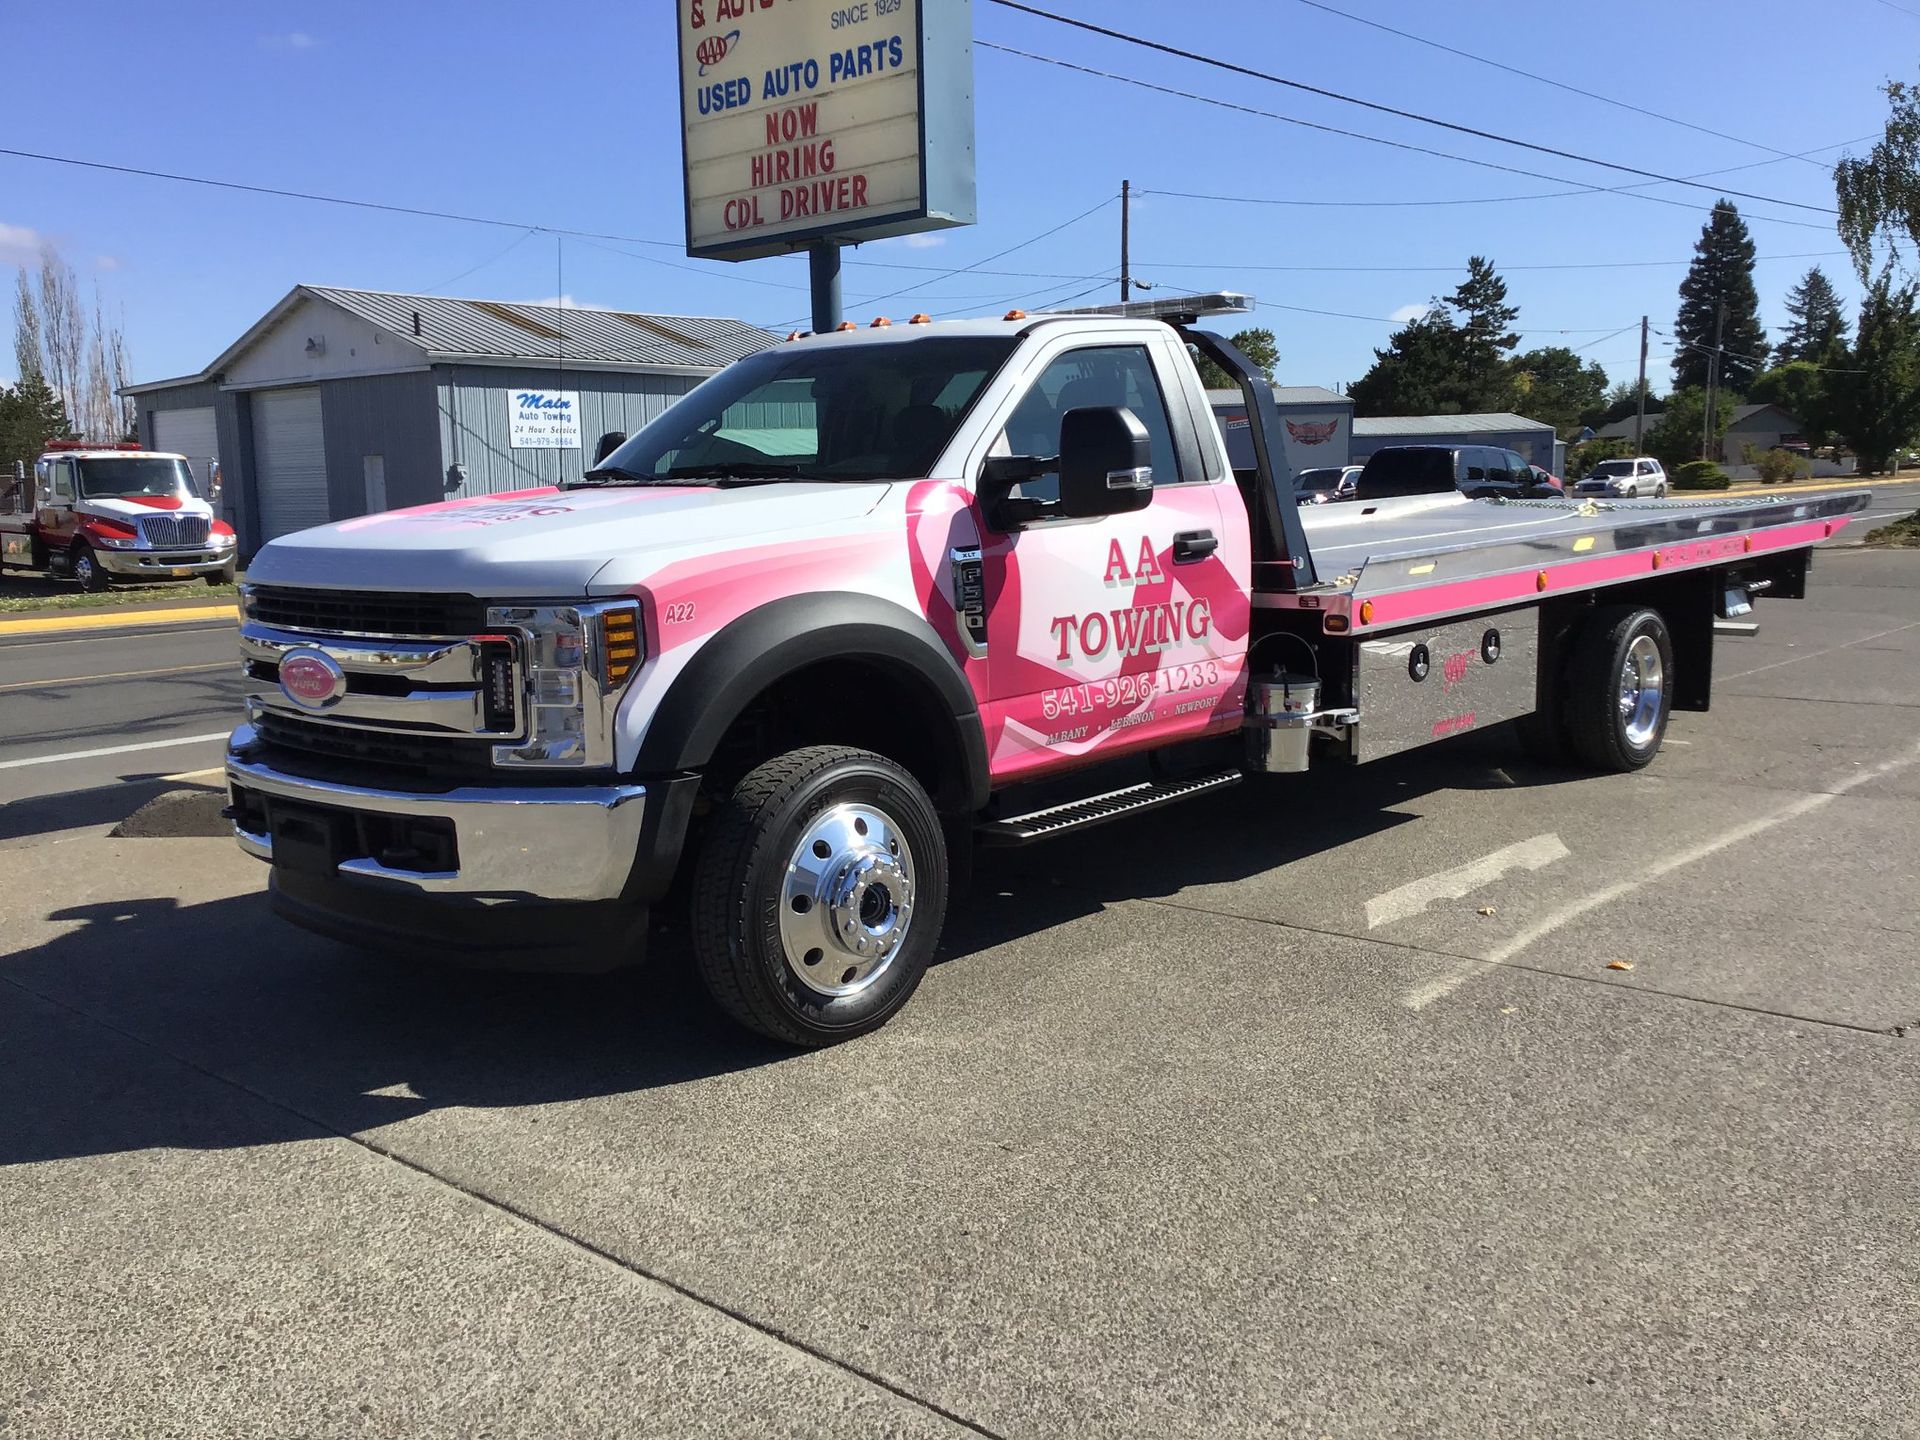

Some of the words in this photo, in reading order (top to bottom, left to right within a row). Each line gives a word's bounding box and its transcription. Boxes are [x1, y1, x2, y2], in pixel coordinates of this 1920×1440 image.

[716, 0, 774, 22] AU
[831, 3, 868, 30] SINCE
[874, 0, 901, 16] 1929
[697, 37, 726, 64] AAA
[698, 77, 751, 115] USED
[763, 59, 818, 99] AUTO
[830, 35, 903, 83] PARTS
[766, 103, 817, 145] NOW
[751, 140, 835, 187] HIRING
[723, 195, 764, 230] CDL
[780, 174, 867, 220] DRIVER
[516, 393, 571, 409] Main
[519, 411, 539, 420] Auto
[542, 411, 571, 423] Towing
[514, 425, 524, 433] 24
[528, 425, 546, 434] Hour
[550, 425, 577, 434] Service
[1103, 535, 1165, 587] AA
[664, 602, 695, 625] A22
[1050, 597, 1212, 665] TOWING
[1041, 661, 1219, 720] 541-926-1233
[1046, 725, 1089, 746] ALBANY
[1109, 710, 1156, 732] LEBANON
[1174, 696, 1218, 715] NEWPORT
